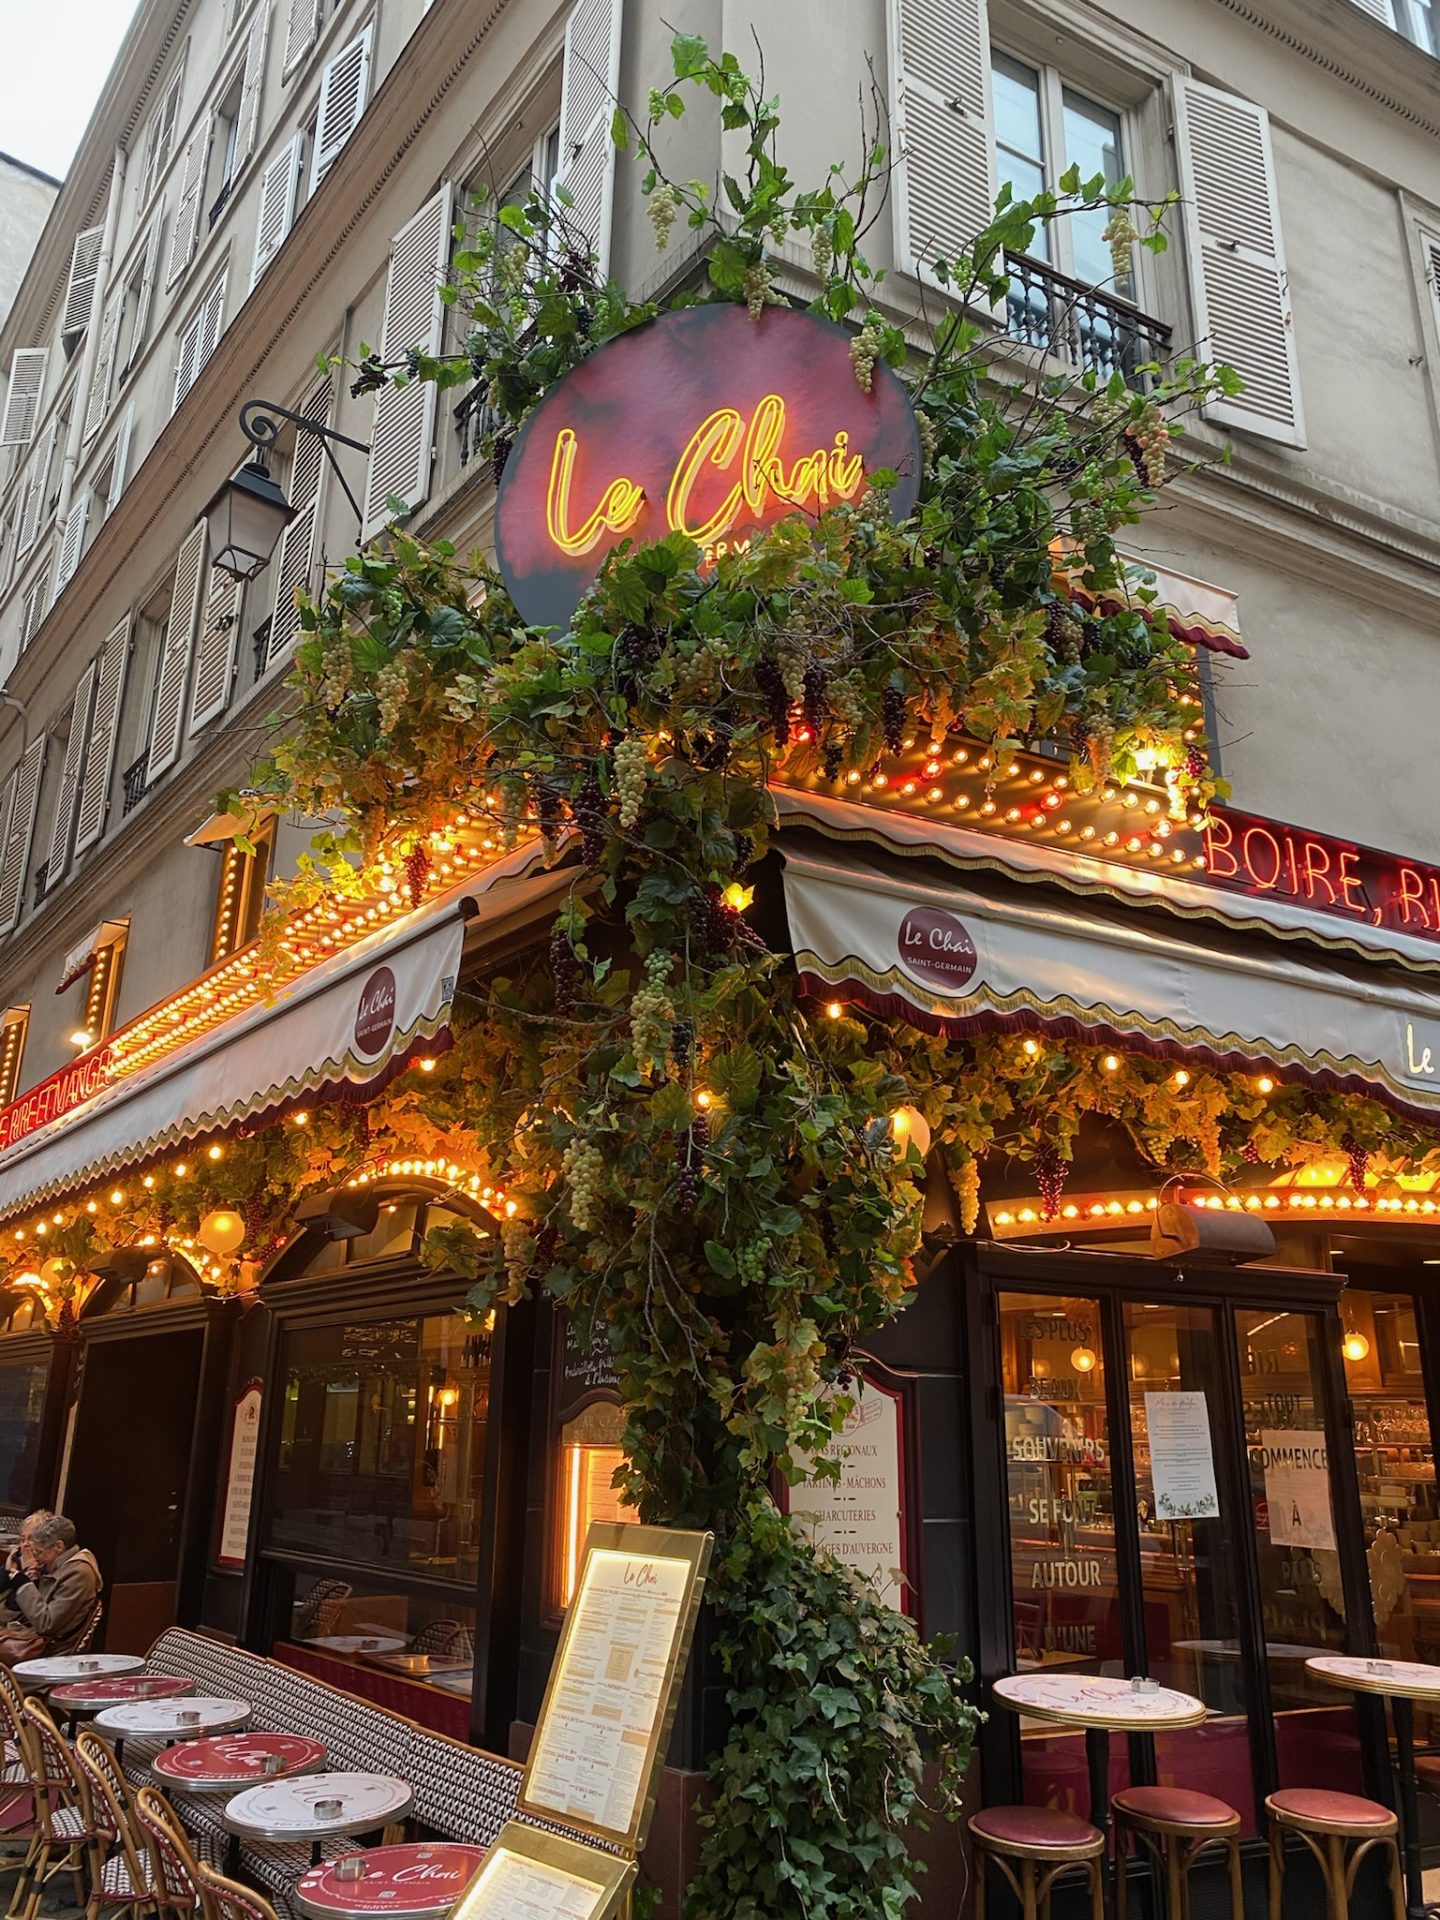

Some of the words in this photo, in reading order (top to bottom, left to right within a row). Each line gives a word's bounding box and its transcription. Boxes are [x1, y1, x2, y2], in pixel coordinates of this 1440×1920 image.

[547, 428, 646, 553] Le
[667, 393, 864, 547] Chai
[1206, 815, 1382, 927] BOIRE,
[904, 921, 922, 945] Le
[929, 927, 973, 954] Chai
[907, 956, 972, 974] SAINT-GERMAIN
[358, 996, 369, 1021] Le
[370, 986, 394, 1014] Chai
[356, 1018, 392, 1038] SAINT-GERMAIN
[1406, 1023, 1435, 1074] Le
[1048, 1319, 1089, 1342] PLUS
[1029, 1375, 1082, 1400] BEAUX
[1265, 1393, 1302, 1413] TOUT
[1251, 1447, 1329, 1471] COMMENCE
[846, 1474, 886, 1489] MÂCHONS
[1029, 1498, 1048, 1524] SE
[1291, 1499, 1302, 1527] À
[842, 1541, 893, 1556] D'AUVERGNE
[1031, 1560, 1102, 1589] AUTOUR
[1044, 1625, 1097, 1651] D'UNE
